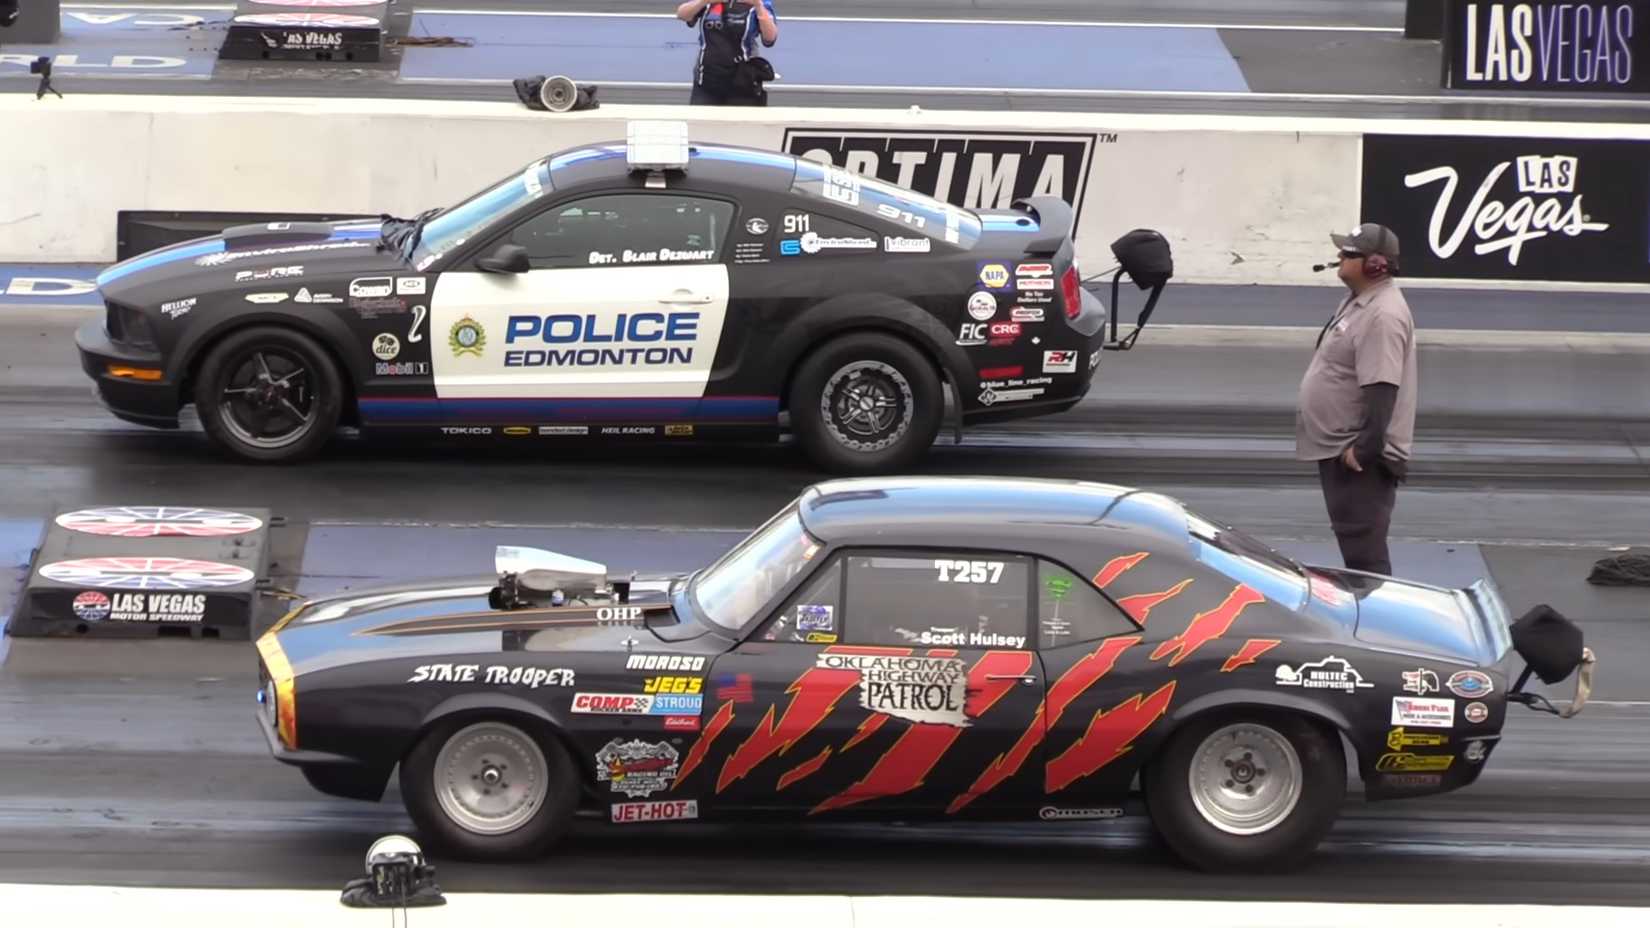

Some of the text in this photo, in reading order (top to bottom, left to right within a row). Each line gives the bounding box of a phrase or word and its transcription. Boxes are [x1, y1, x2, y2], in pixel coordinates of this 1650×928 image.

[1099, 132, 1118, 143] TM
[1523, 160, 1572, 189] LAS
[877, 203, 926, 228] 911
[1404, 161, 1609, 266] Vegas
[783, 214, 810, 233] 911
[985, 269, 1004, 280] NAPA
[505, 312, 700, 344] POLICE
[959, 323, 989, 339] FIC
[375, 344, 397, 355] dice
[504, 347, 693, 367] EDMONTON
[440, 426, 493, 435] TOKICO
[623, 426, 655, 435] RACING
[934, 559, 1004, 584] T257
[111, 593, 206, 613] LAS VEGAS
[110, 613, 204, 621] MOTOR SPEEDWAY
[596, 606, 642, 621] OHP
[920, 631, 1026, 649] Scott Hulsey
[626, 654, 705, 671] MOROSO
[825, 655, 960, 671] OKLAHOMA
[408, 664, 576, 689] STATE TROOPER
[867, 670, 958, 684] HIGHWAY
[644, 677, 703, 694] JEG'S
[575, 695, 634, 709] COMP
[655, 695, 702, 709] STROUD
[867, 682, 958, 711] PATROL
[614, 803, 687, 821] JET-HOT
